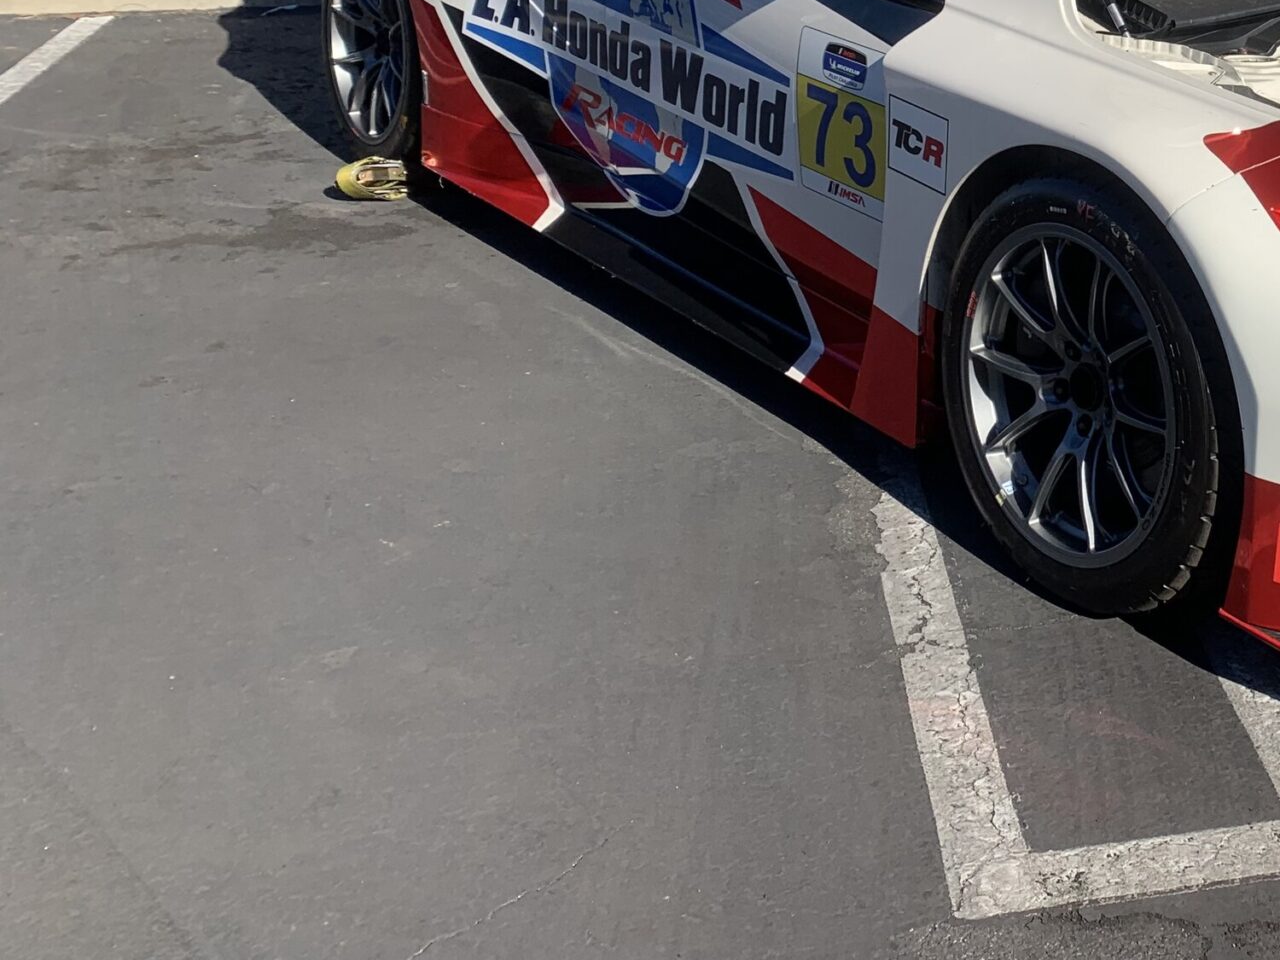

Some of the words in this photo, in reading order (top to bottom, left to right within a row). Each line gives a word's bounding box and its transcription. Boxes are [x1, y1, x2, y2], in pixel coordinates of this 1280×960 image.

[562, 84, 688, 166] RACING
[660, 38, 787, 157] World
[807, 83, 876, 188] 73
[892, 118, 944, 168] TCR
